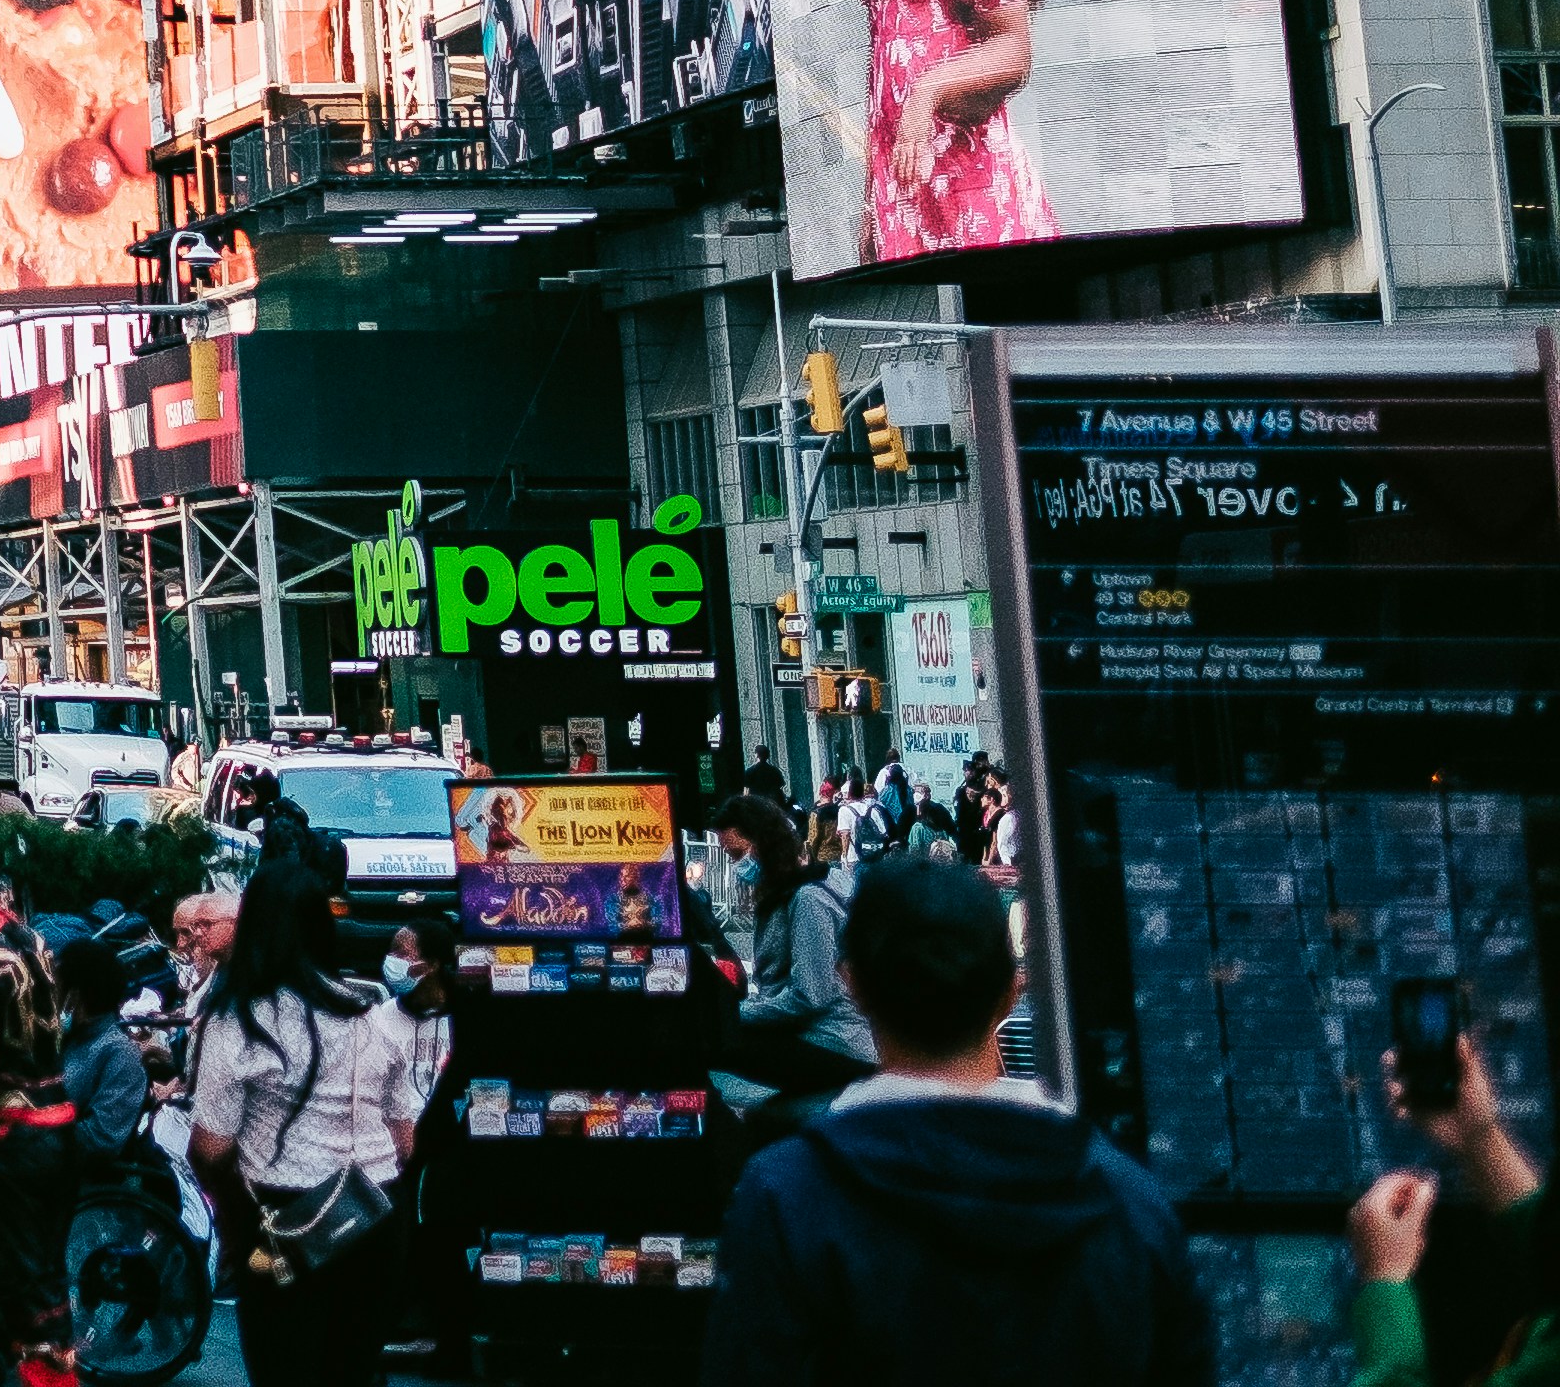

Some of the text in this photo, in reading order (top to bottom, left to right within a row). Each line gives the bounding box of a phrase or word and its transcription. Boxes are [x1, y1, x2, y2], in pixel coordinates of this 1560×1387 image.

[1077, 408, 1379, 433] 7 Avenue & W 45 Street
[1081, 456, 1258, 484] Times Square
[352, 479, 421, 657] pelé
[434, 494, 703, 653] pelé
[827, 577, 840, 593] W
[844, 576, 862, 593] 46
[371, 627, 416, 658] SOCCER
[500, 629, 670, 654] SOCCER
[537, 821, 664, 845] THE LION KING
[366, 862, 448, 876] SCHOOL SAFETY
